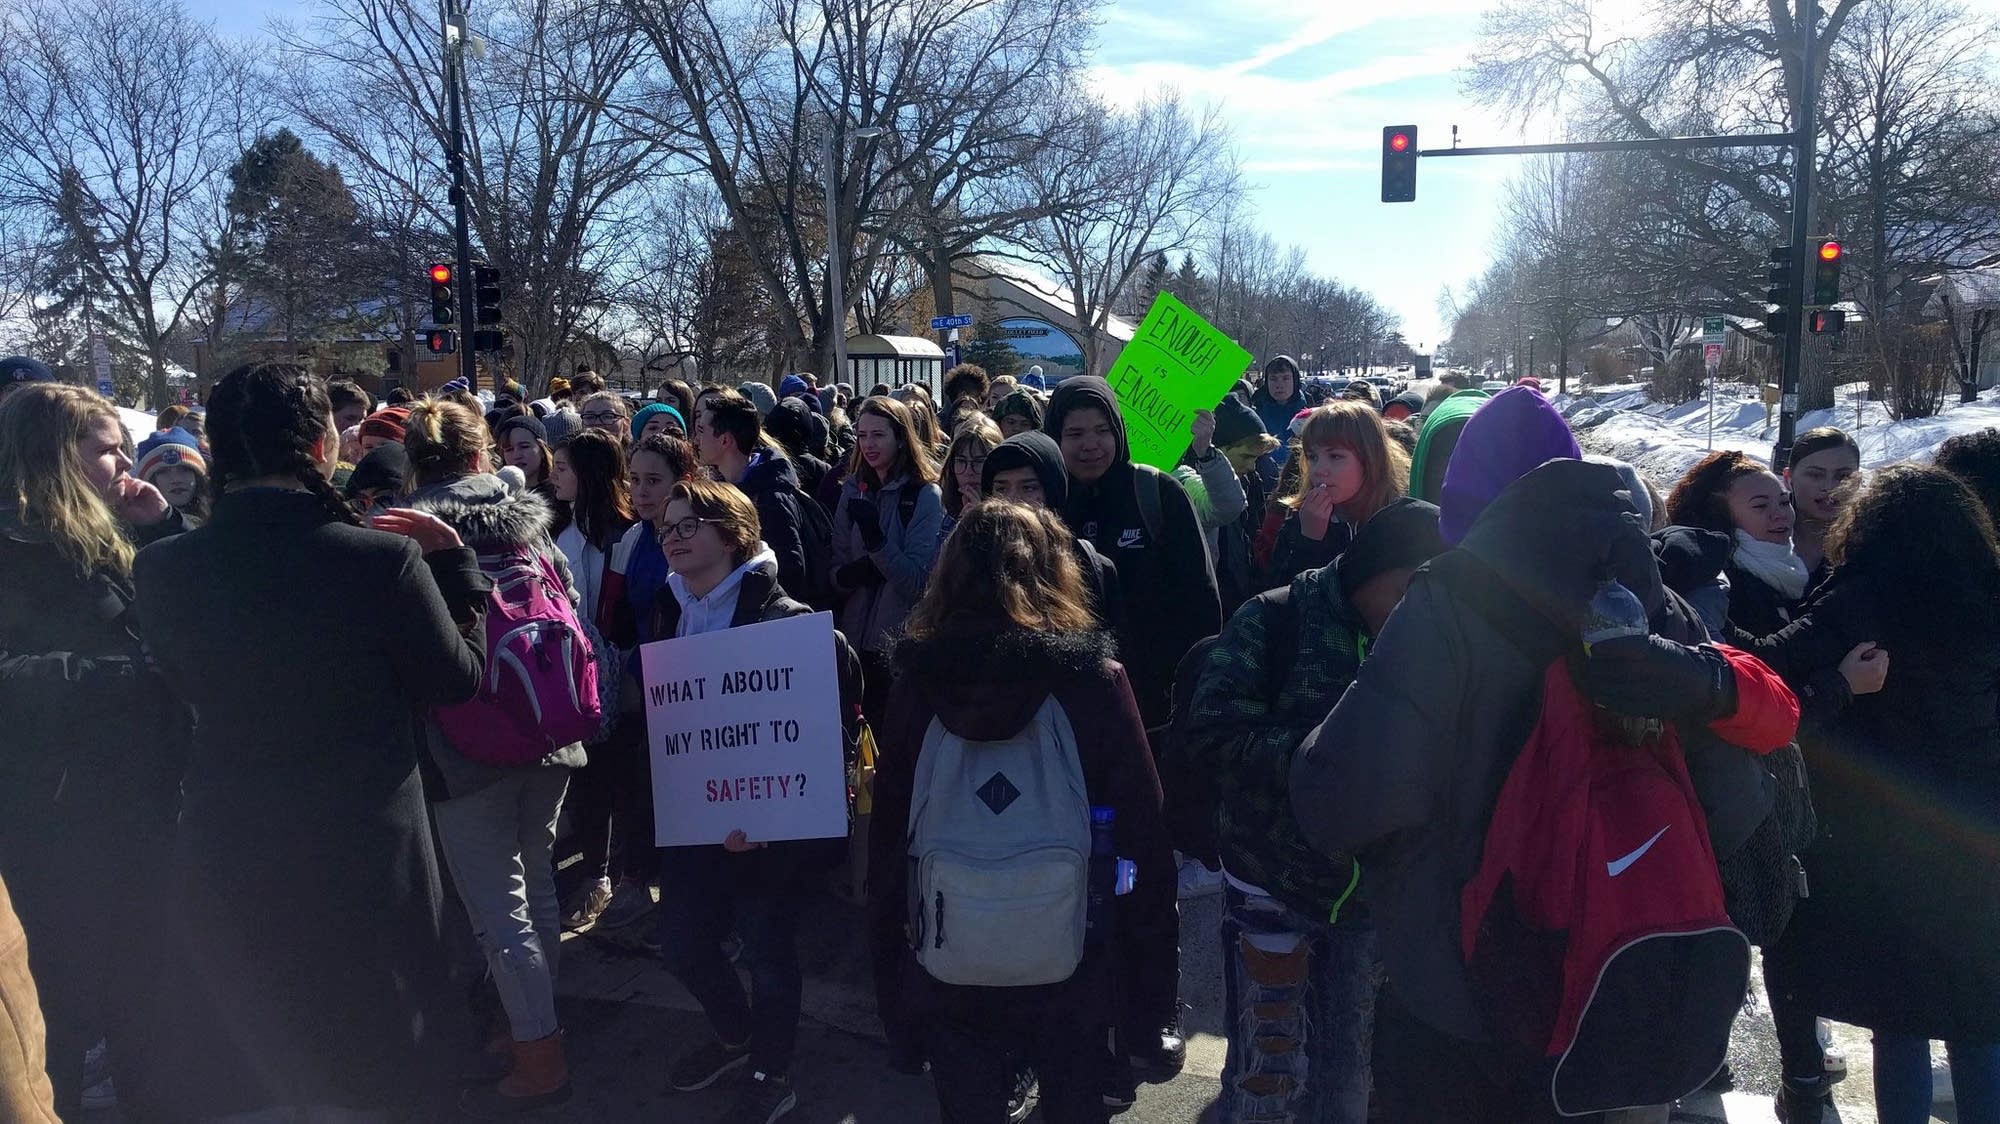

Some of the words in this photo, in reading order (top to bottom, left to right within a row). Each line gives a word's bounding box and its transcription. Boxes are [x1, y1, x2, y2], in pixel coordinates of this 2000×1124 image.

[939, 319, 944, 327] E
[945, 318, 962, 327] 40th
[964, 317, 972, 325] St
[1149, 305, 1222, 376] ENOUGH
[1114, 364, 1187, 434] ENOUGH
[1122, 528, 1141, 539] NIKE
[650, 677, 706, 707] WHAT
[721, 667, 794, 695] ABOUT
[665, 732, 692, 756] MY
[701, 722, 760, 751] RIGHT
[769, 719, 800, 743] TO
[706, 773, 807, 802] SAFETY?
